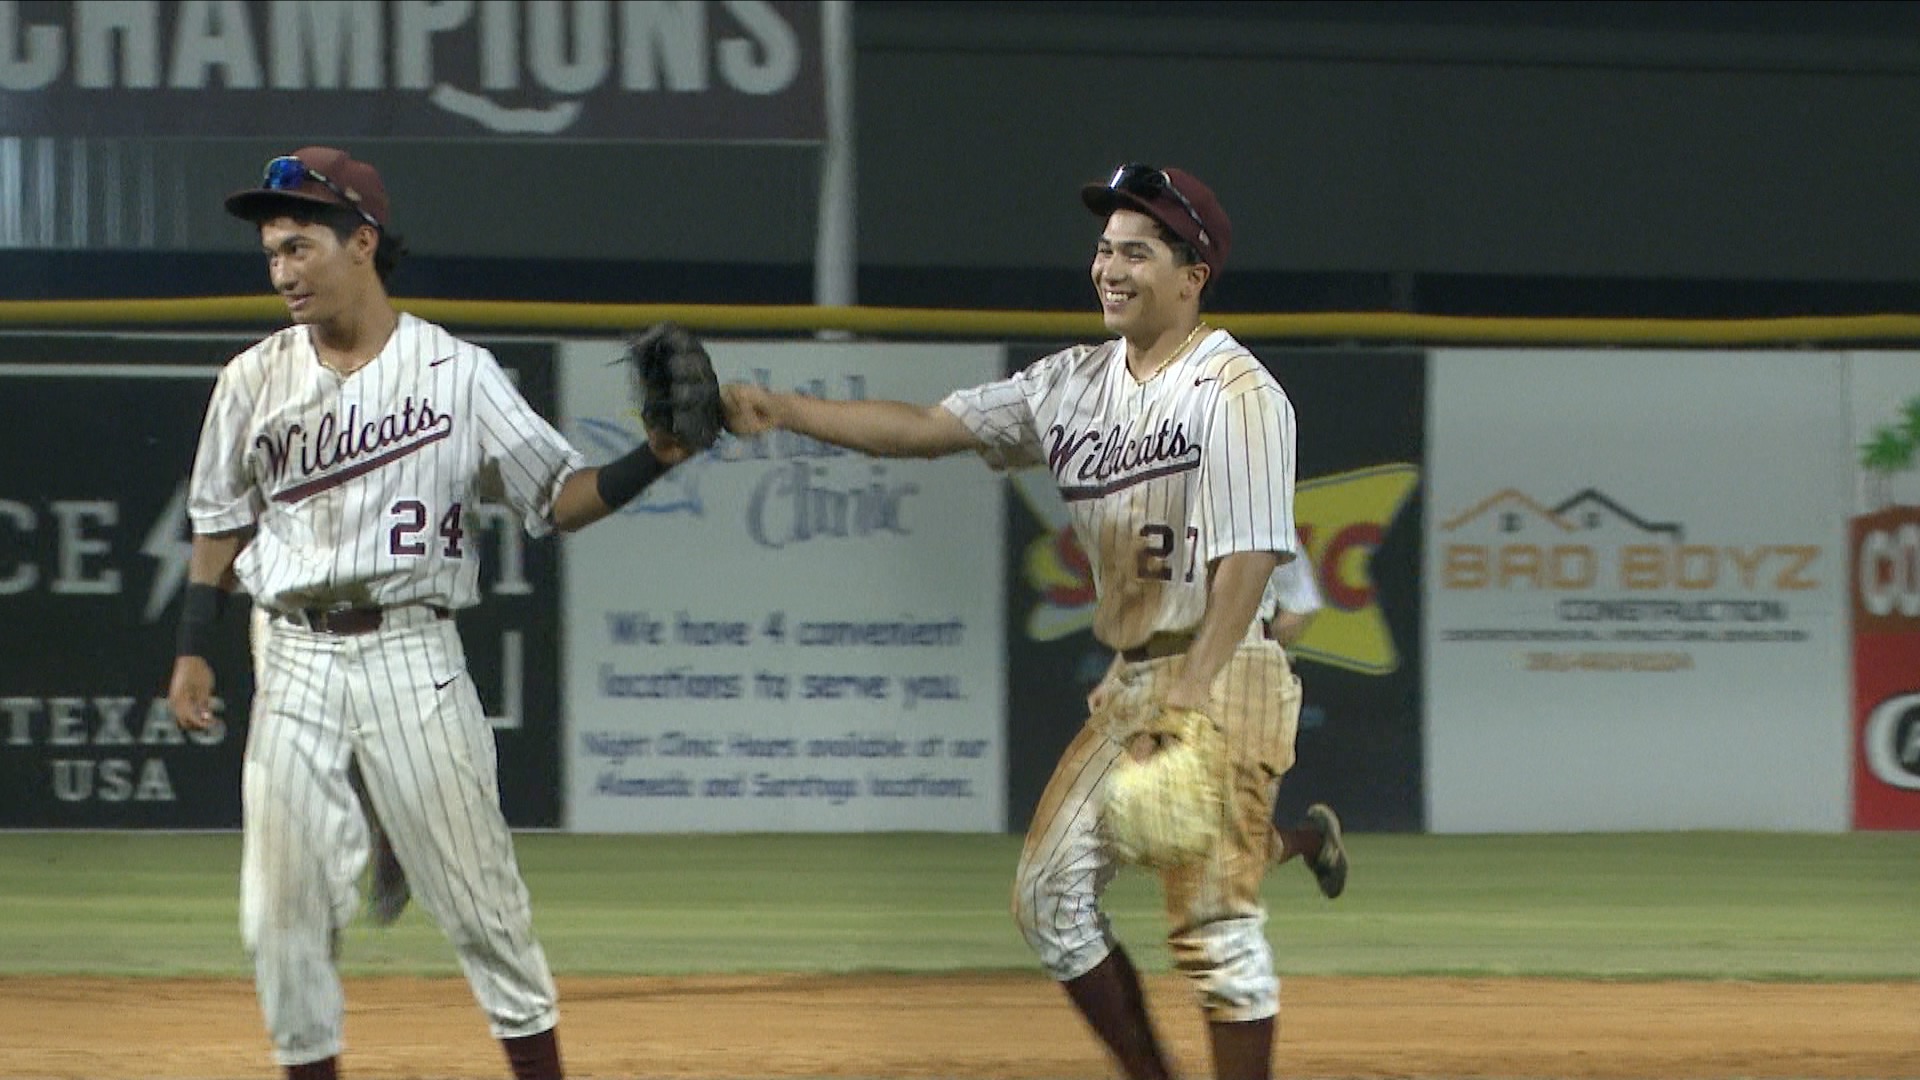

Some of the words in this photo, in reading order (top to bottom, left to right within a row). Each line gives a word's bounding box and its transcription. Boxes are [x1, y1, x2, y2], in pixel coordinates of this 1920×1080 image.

[256, 396, 452, 482] Wildcats
[1049, 418, 1202, 481] Wildcats
[389, 499, 464, 559] 24
[1617, 543, 1823, 590] BOYZ
[605, 612, 663, 645] We
[760, 611, 785, 645] 4
[2, 697, 226, 745] TEXAS
[51, 759, 176, 801] USA
